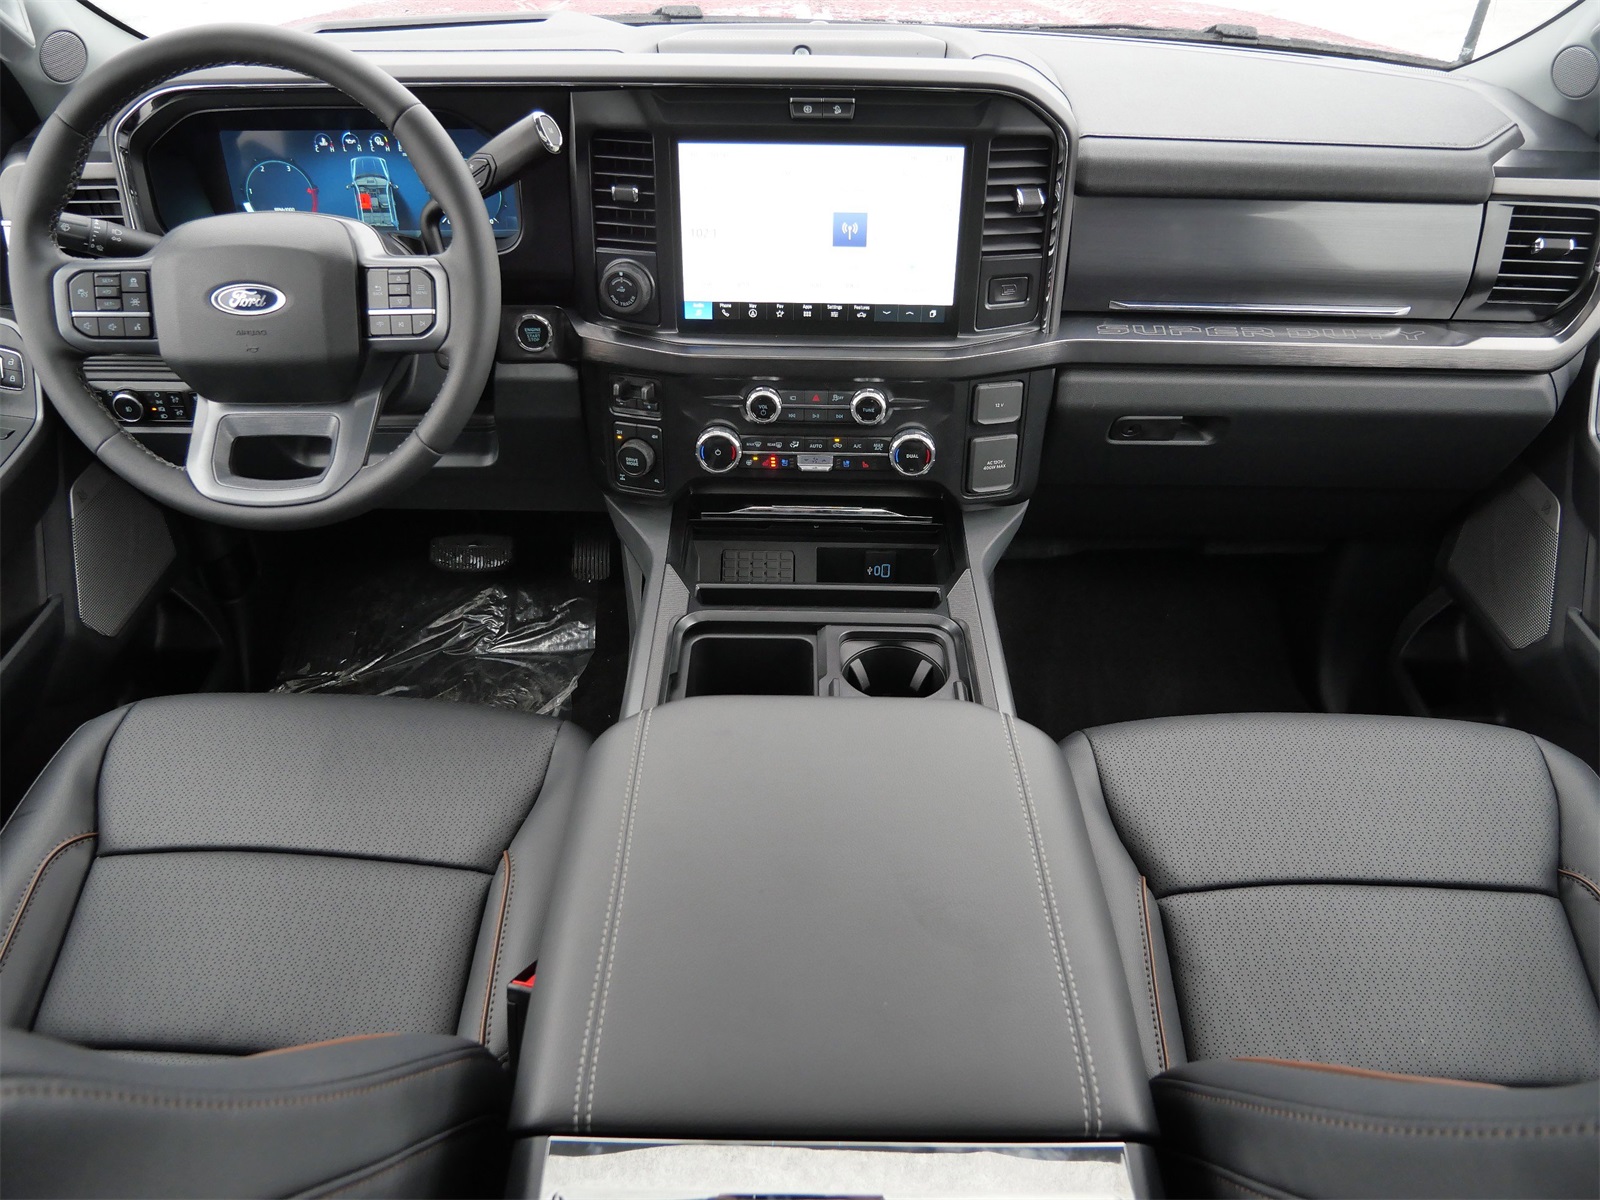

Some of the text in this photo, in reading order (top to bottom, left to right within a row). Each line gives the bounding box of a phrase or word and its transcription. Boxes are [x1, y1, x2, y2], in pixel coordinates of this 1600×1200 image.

[228, 289, 267, 308] Ford
[1096, 323, 1425, 341] SUPER DUTY
